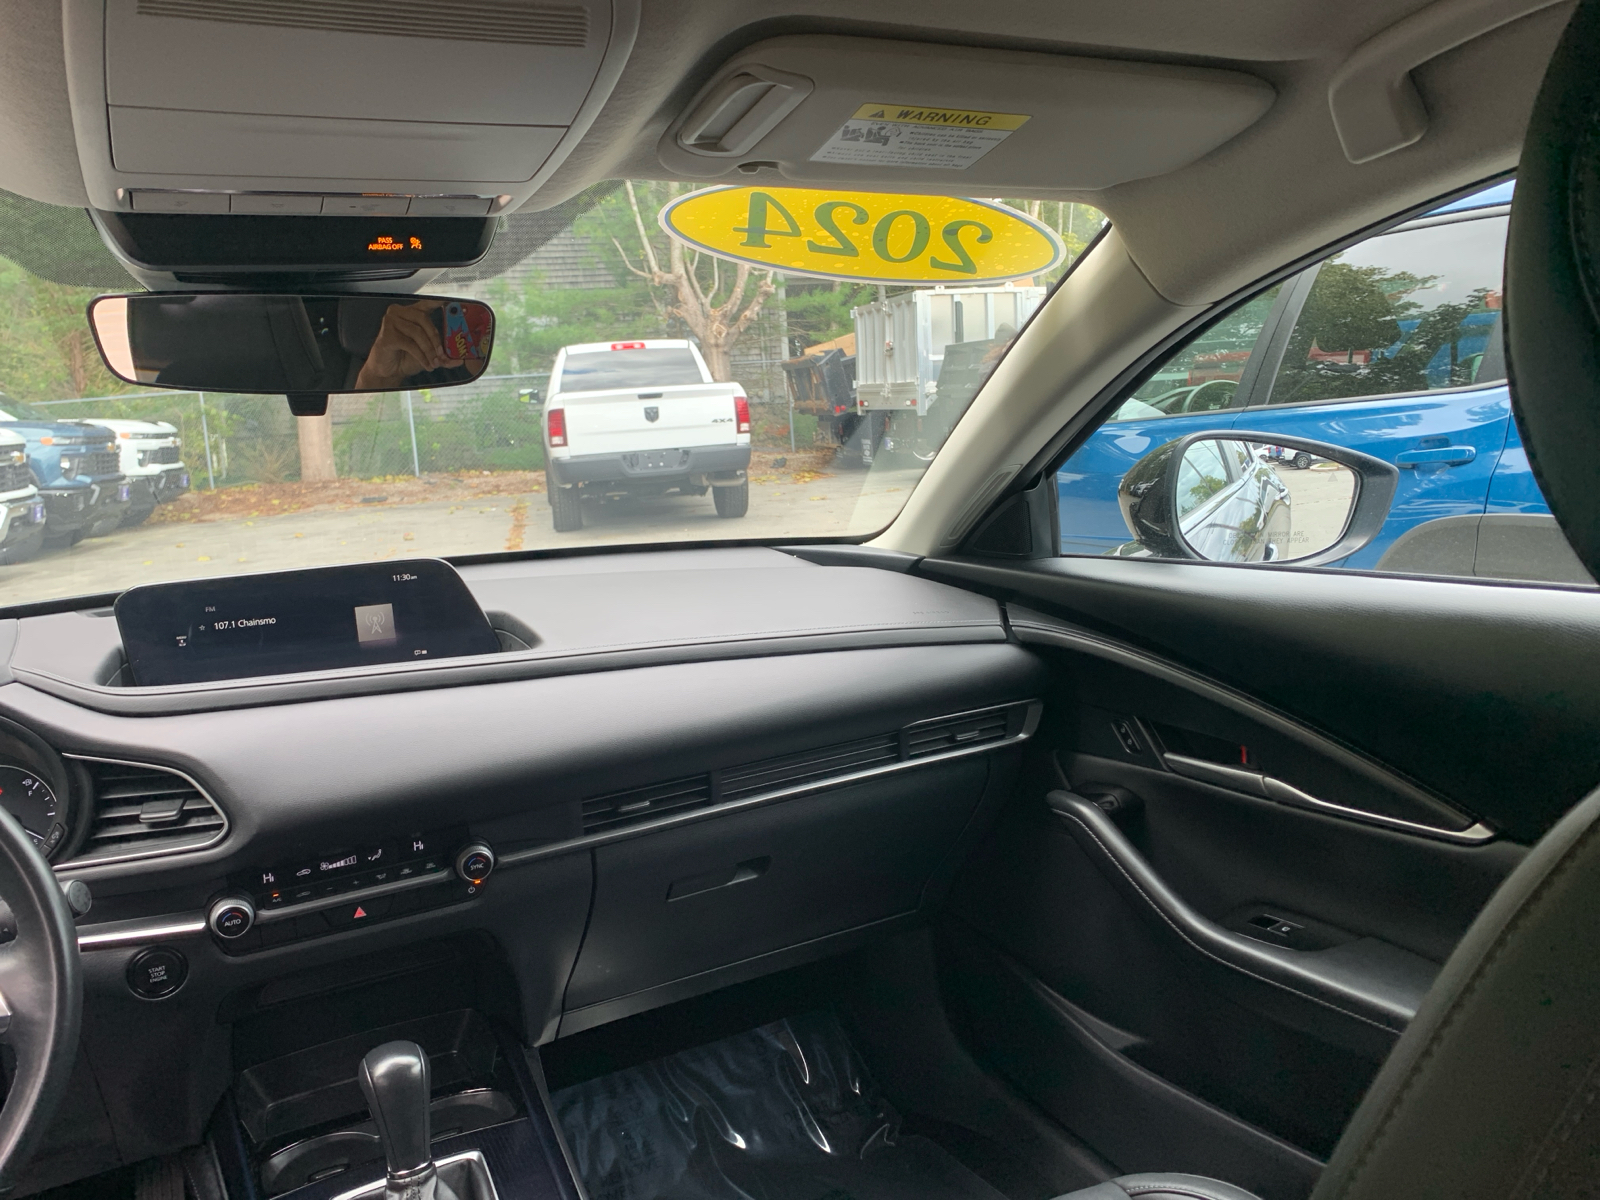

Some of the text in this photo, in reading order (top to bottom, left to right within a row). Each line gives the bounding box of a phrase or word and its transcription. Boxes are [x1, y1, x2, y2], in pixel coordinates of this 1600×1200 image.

[897, 109, 992, 126] WARNING
[378, 236, 393, 244] PASS
[1286, 536, 1310, 544] APPEAR
[214, 617, 277, 630] 107.1 Chainsmo
[470, 862, 485, 871] SYNC
[224, 918, 242, 927] AUTO
[148, 965, 166, 974] START
[150, 970, 166, 979] STOP
